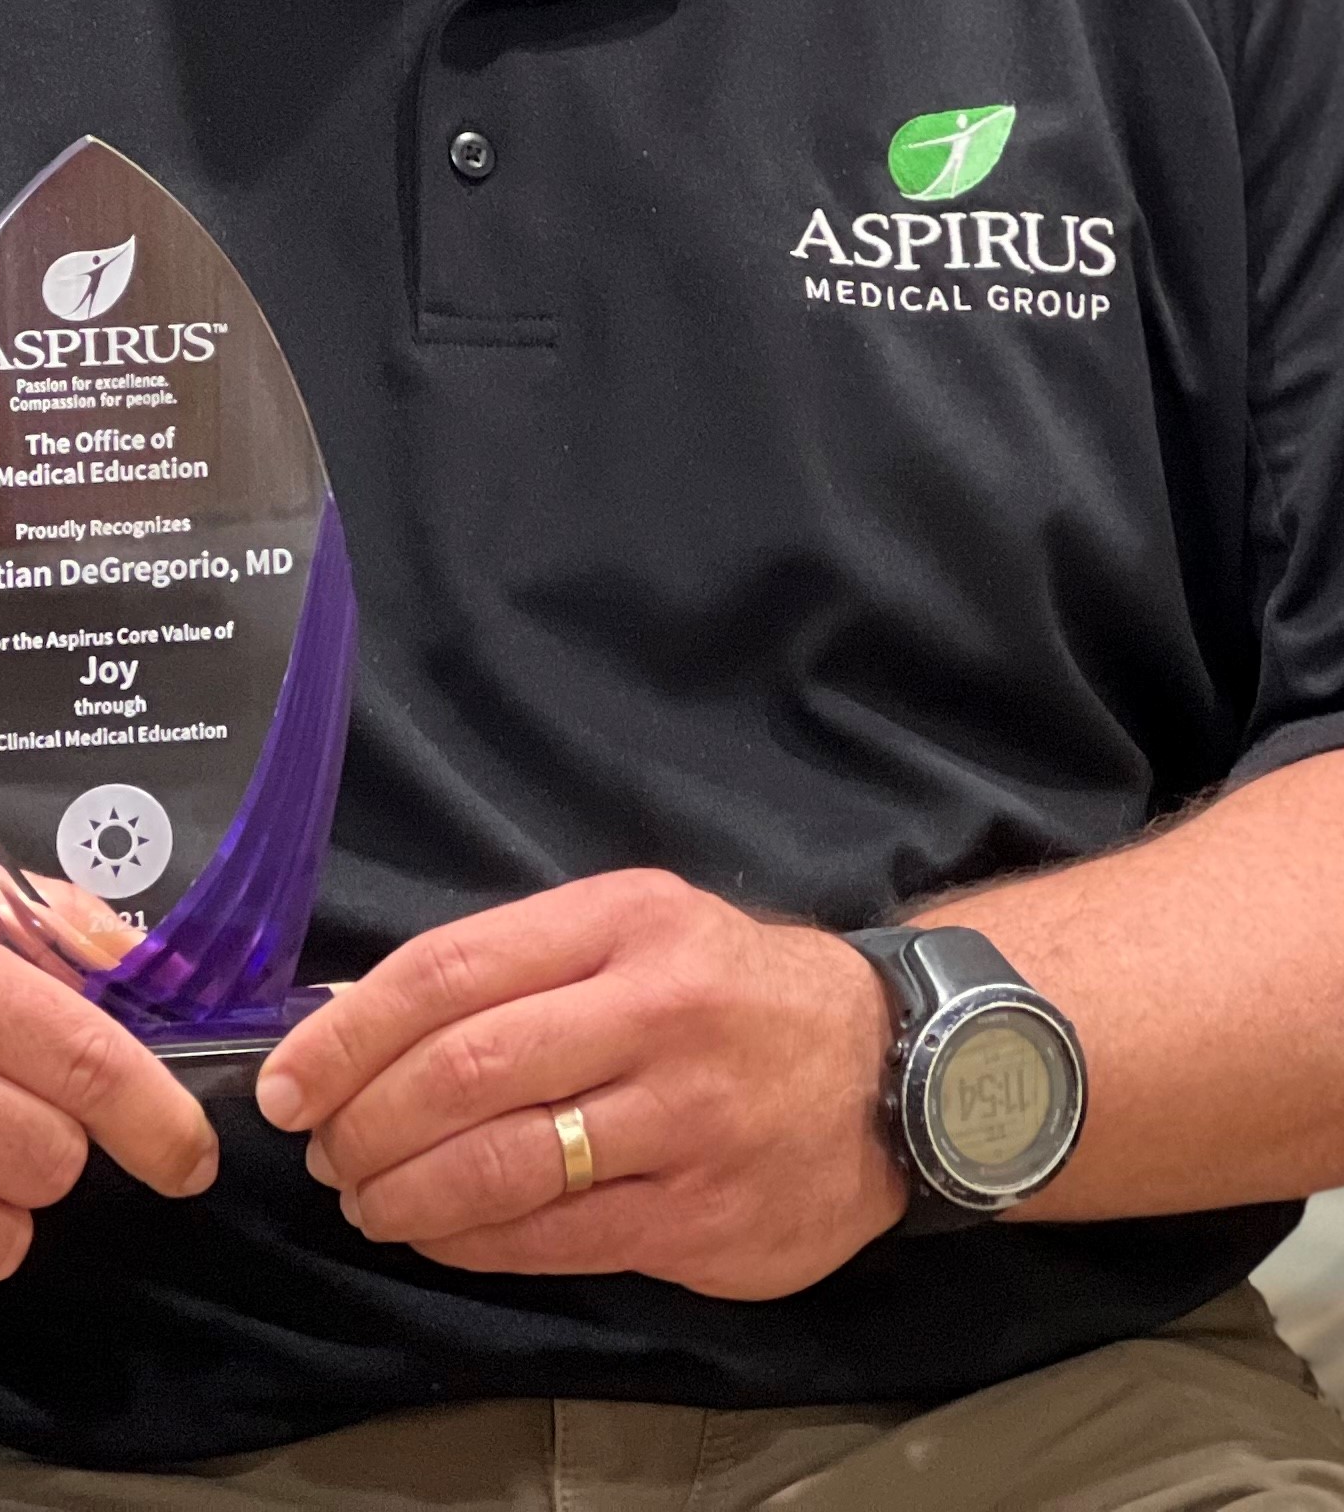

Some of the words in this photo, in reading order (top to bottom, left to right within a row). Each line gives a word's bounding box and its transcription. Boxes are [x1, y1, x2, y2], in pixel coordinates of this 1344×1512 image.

[790, 209, 1116, 277] ASPIRUS
[805, 276, 971, 311] MEDICAL
[987, 285, 1109, 320] GROUP
[17, 378, 67, 393] Passion
[72, 376, 92, 391] for
[95, 374, 169, 390] excellence.
[10, 391, 96, 413] Compassion
[100, 392, 122, 407] for
[126, 390, 177, 408] people.
[25, 433, 70, 455] The
[75, 429, 145, 452] Office
[151, 426, 175, 449] of
[91, 457, 208, 483] Education
[16, 520, 86, 541] Proudly
[90, 516, 191, 538] Recognizes
[60, 551, 238, 584] DeGregorio,
[246, 549, 292, 575] MD
[12, 632, 43, 650] the
[46, 629, 113, 651] Aspirus
[117, 628, 158, 644] Core
[161, 624, 211, 642] Value
[215, 621, 234, 639] of
[80, 656, 138, 690] Joy
[74, 695, 146, 717] through
[65, 726, 134, 747] Medical
[138, 722, 227, 742] Education
[89, 909, 148, 934] 2021
